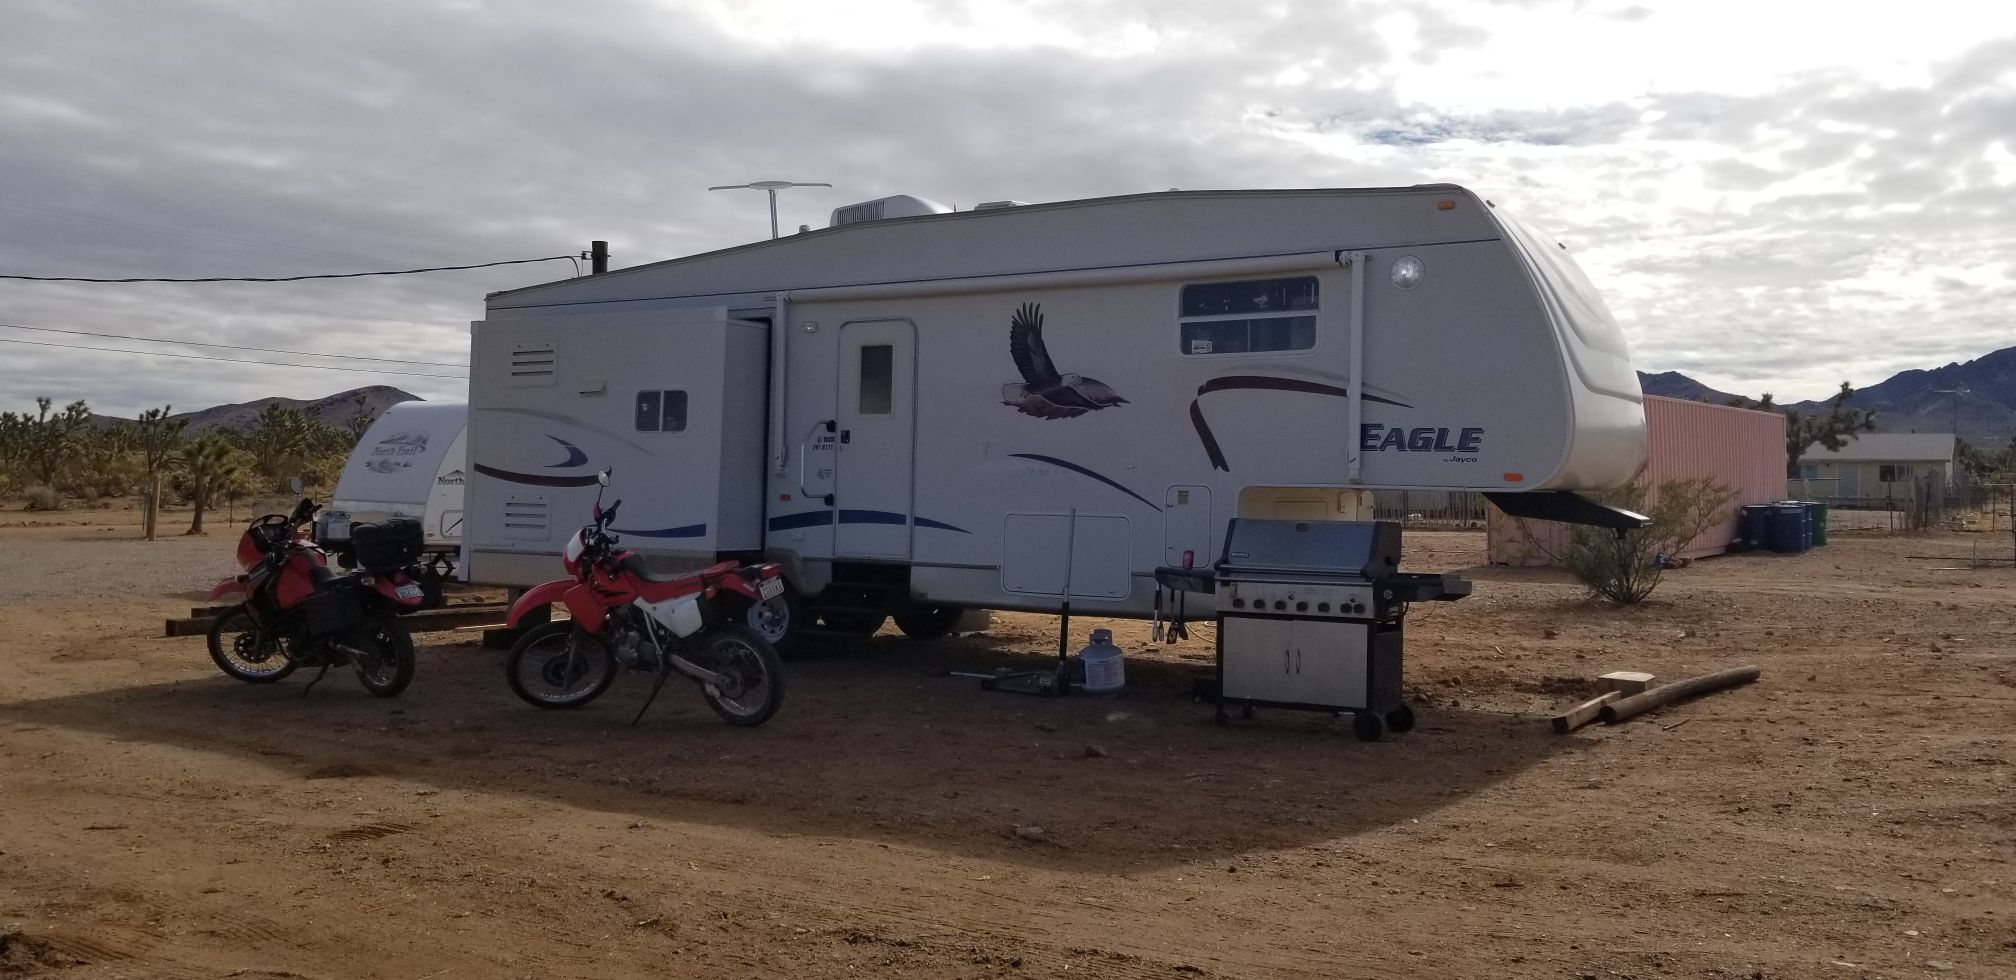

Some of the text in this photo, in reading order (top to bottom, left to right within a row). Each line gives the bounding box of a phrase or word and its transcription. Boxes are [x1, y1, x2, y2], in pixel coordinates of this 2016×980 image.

[1360, 423, 1484, 453] EAGLE
[1450, 455, 1478, 464] Jayco
[438, 476, 465, 486] North
